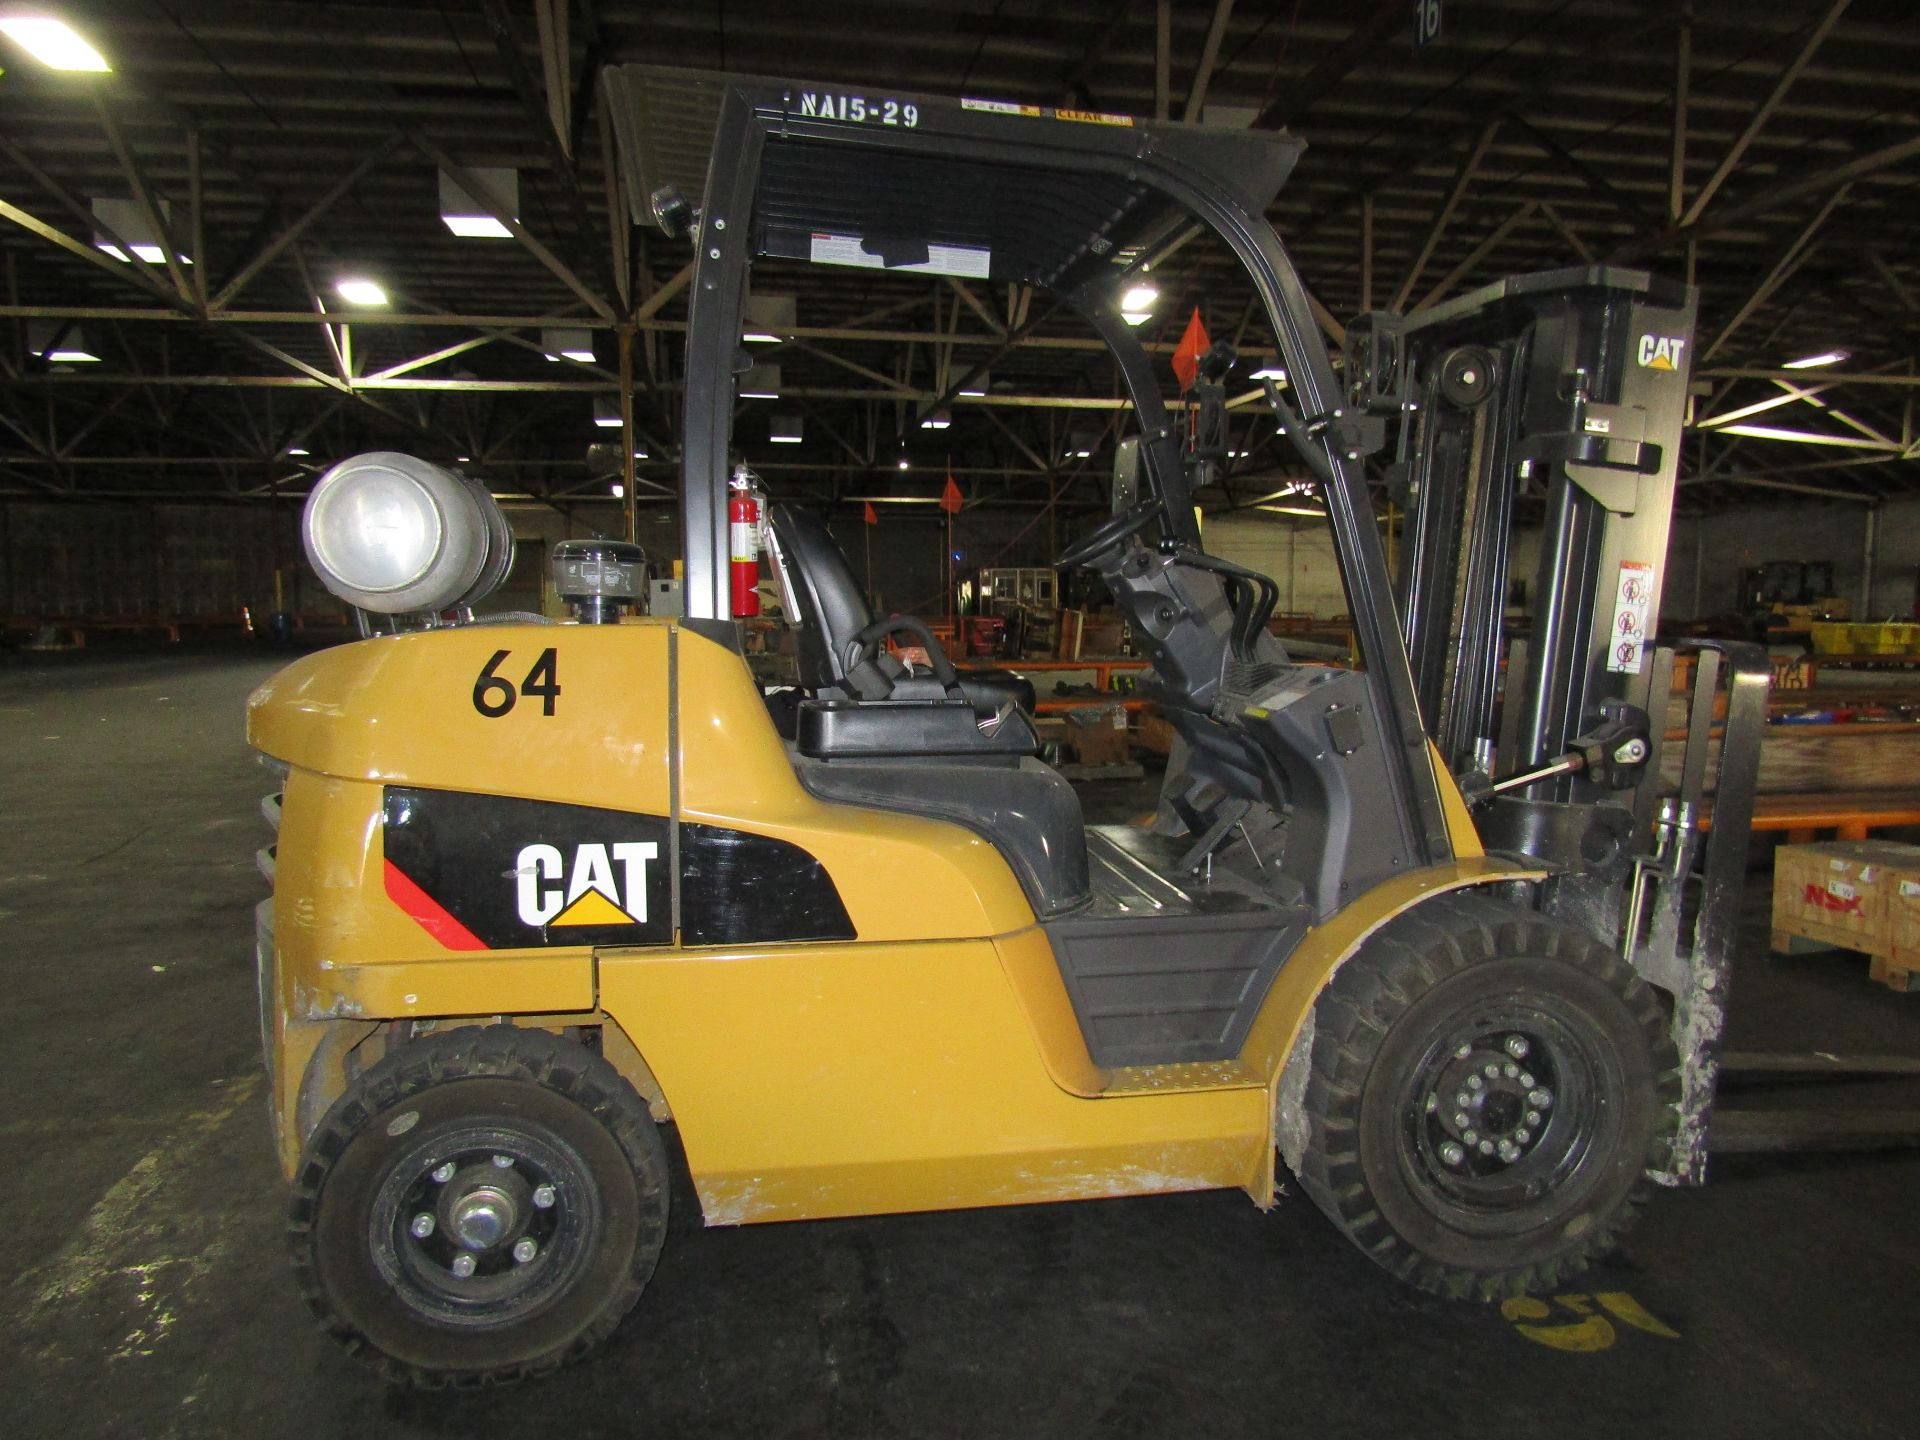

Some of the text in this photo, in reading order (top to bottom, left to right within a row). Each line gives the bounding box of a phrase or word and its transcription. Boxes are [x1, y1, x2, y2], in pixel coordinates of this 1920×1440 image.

[1638, 333, 1685, 371] CAT
[472, 647, 561, 719] 64
[517, 841, 658, 927] CAT
